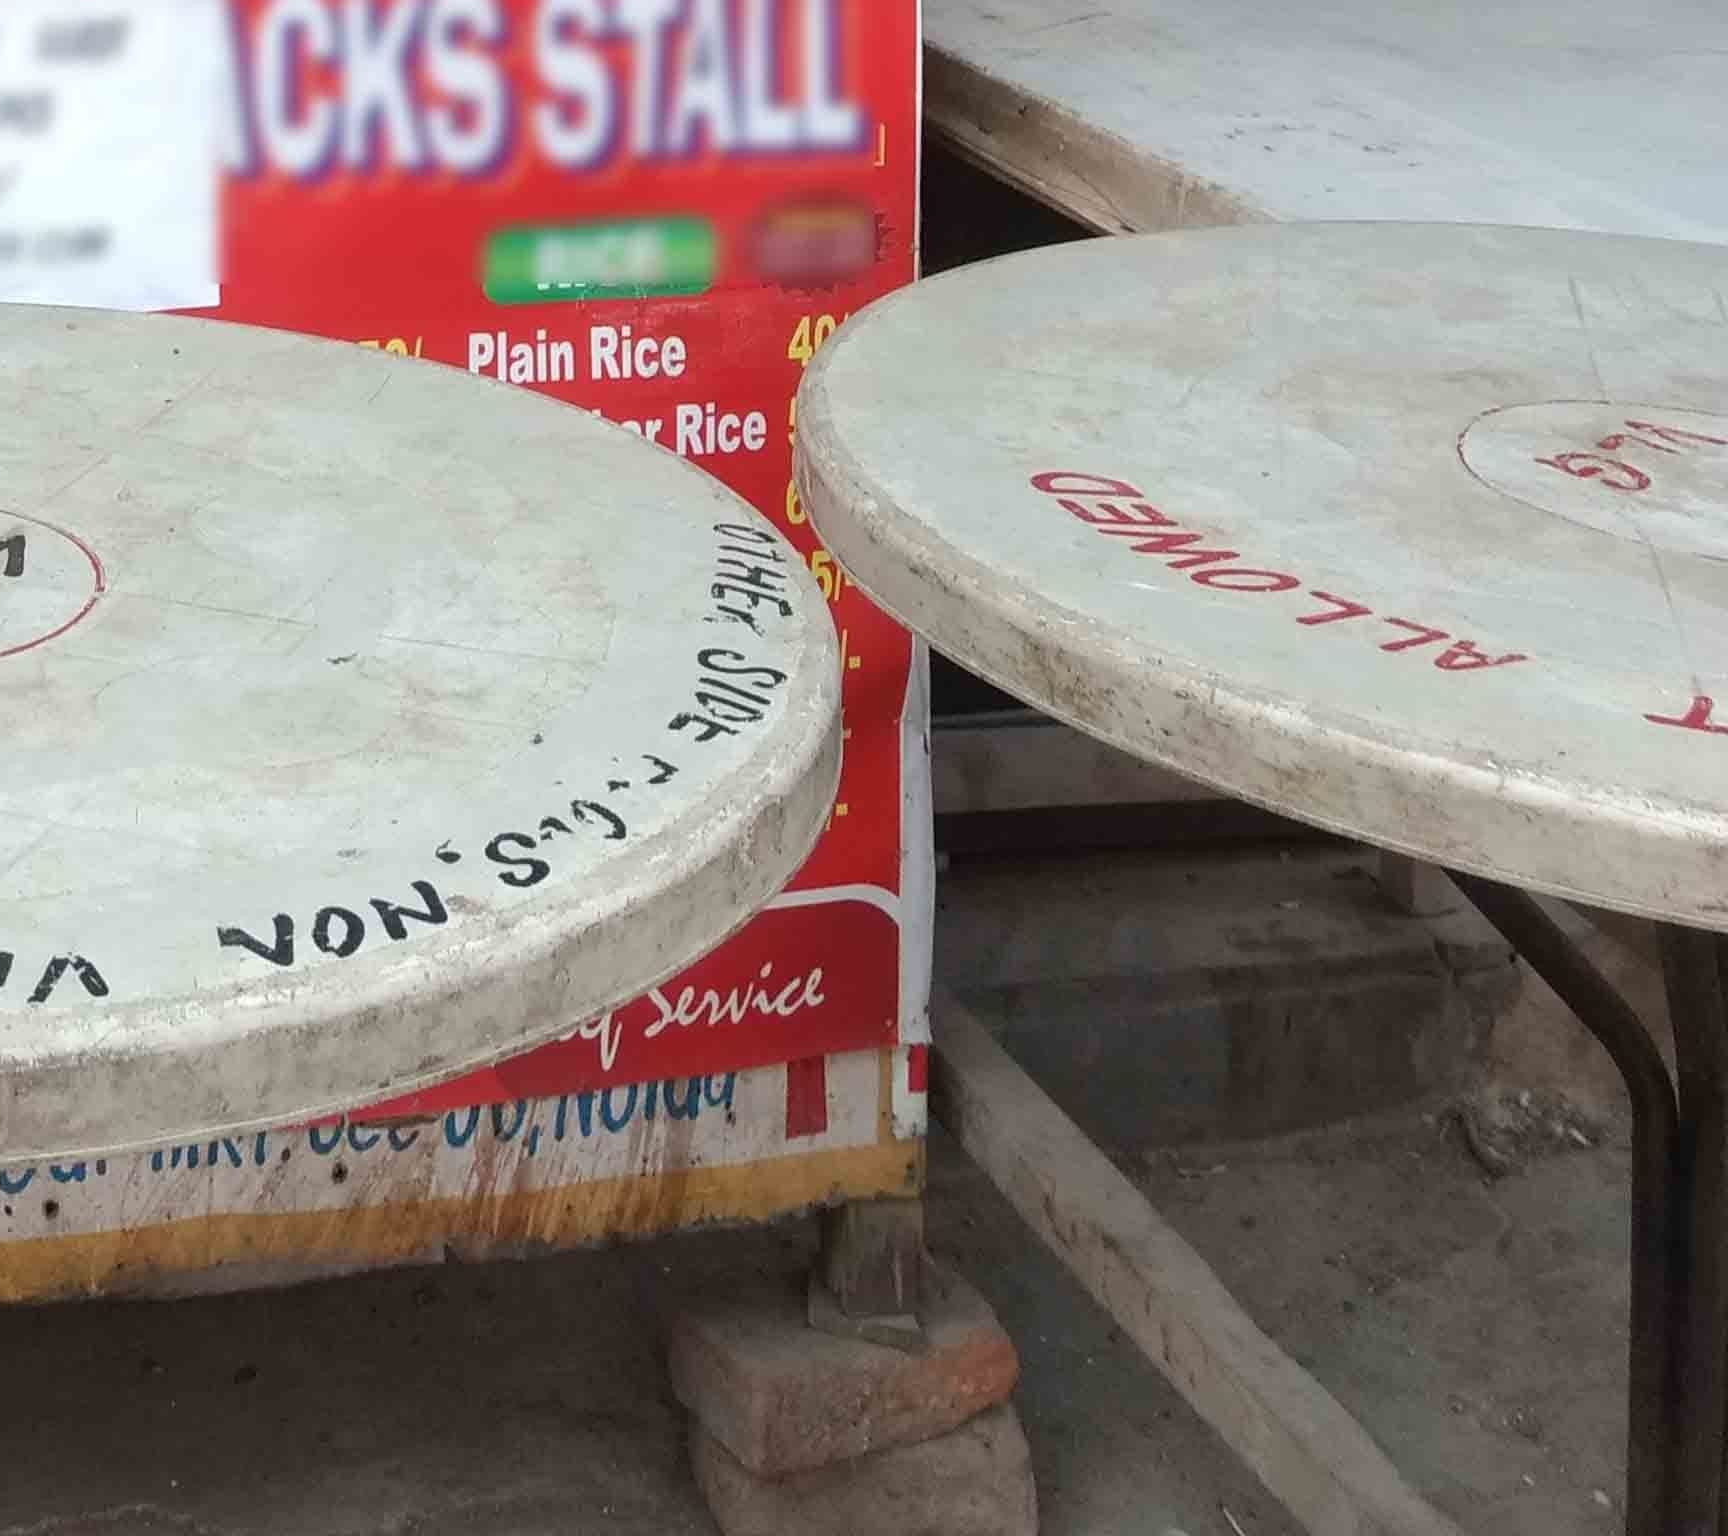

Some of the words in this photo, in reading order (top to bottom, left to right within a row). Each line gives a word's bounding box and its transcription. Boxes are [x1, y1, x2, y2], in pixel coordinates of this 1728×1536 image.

[468, 328, 574, 385] Plain
[589, 324, 687, 380] Rice
[674, 402, 768, 457] Rice
[1029, 470, 1529, 672] ALLOWED
[216, 880, 449, 967] NON
